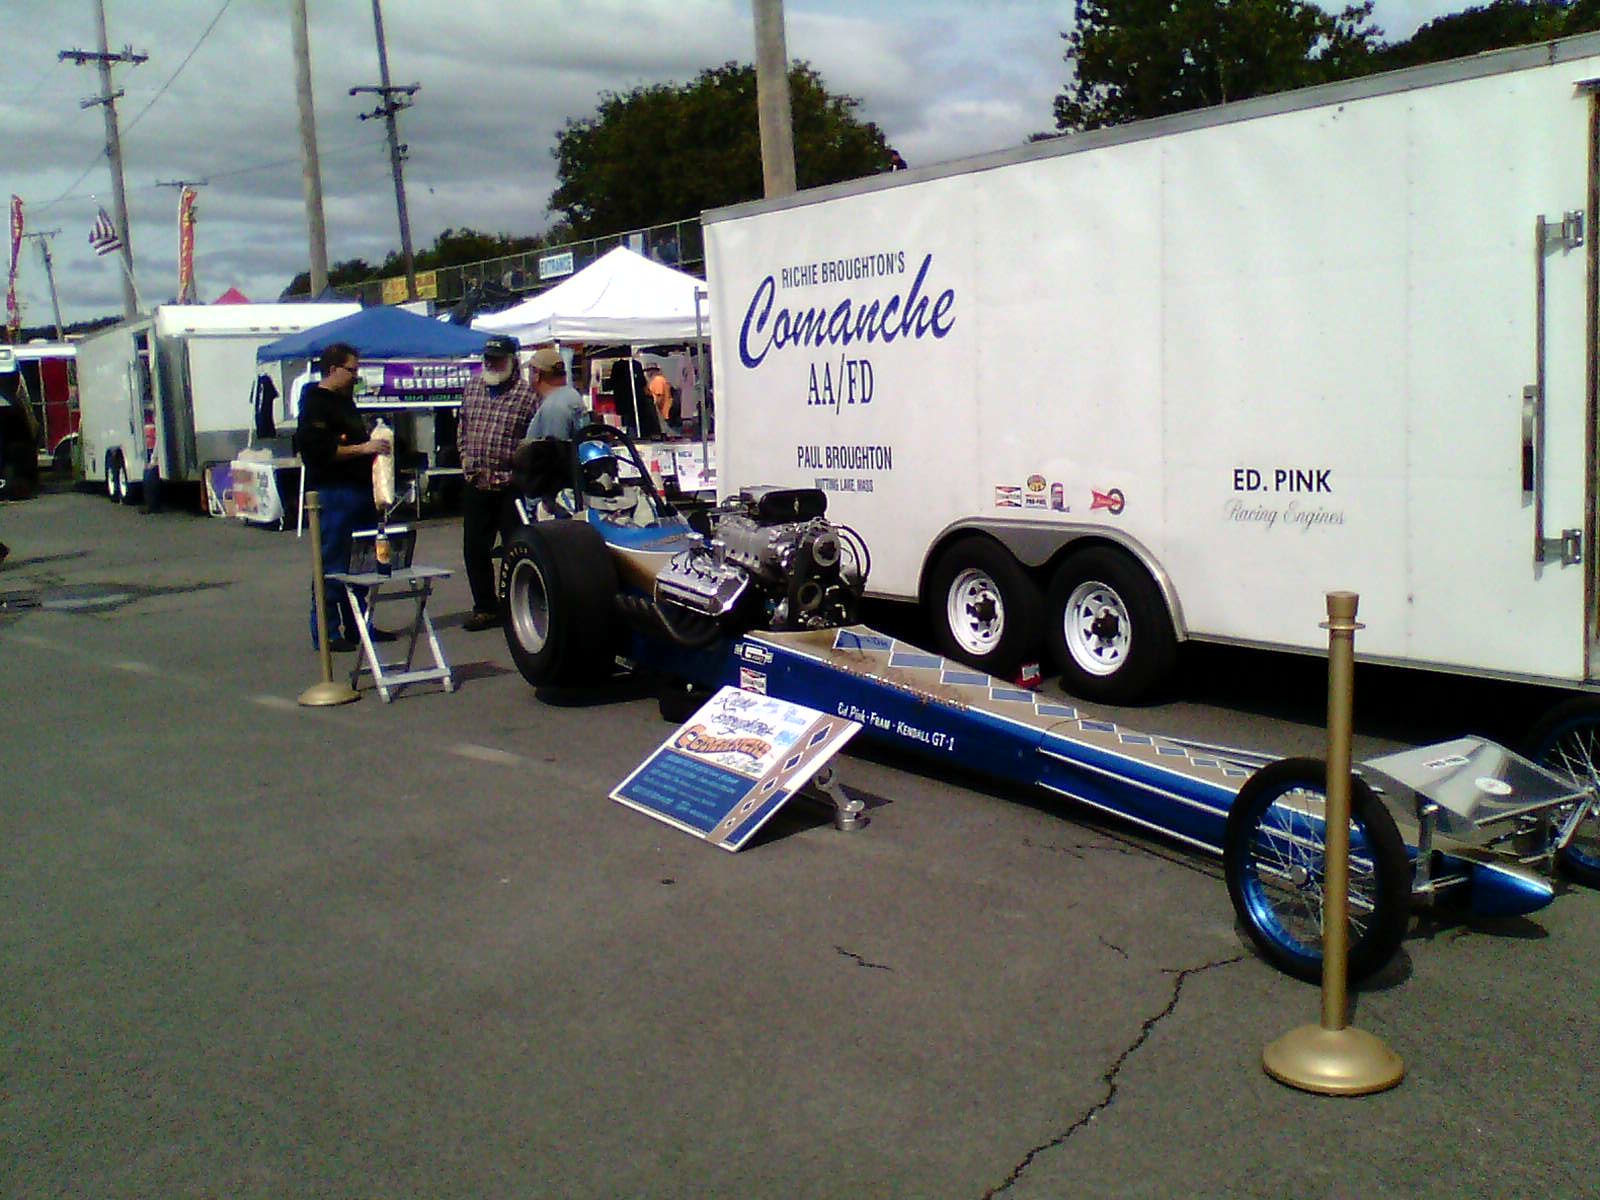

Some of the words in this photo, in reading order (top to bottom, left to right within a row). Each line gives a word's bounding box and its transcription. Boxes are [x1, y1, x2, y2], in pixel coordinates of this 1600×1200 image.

[781, 263, 818, 289] RICHIE
[821, 251, 905, 284] BROUGHTON'S
[738, 253, 956, 369] Comanche
[807, 353, 874, 415] AA/FD
[797, 446, 823, 469] PAUL
[825, 446, 892, 470] BROUGHTON
[1233, 469, 1268, 491] ED.
[1275, 469, 1332, 492] PINK
[1224, 498, 1278, 530] Racing
[1283, 500, 1345, 532] Engines
[837, 702, 849, 716] Ed
